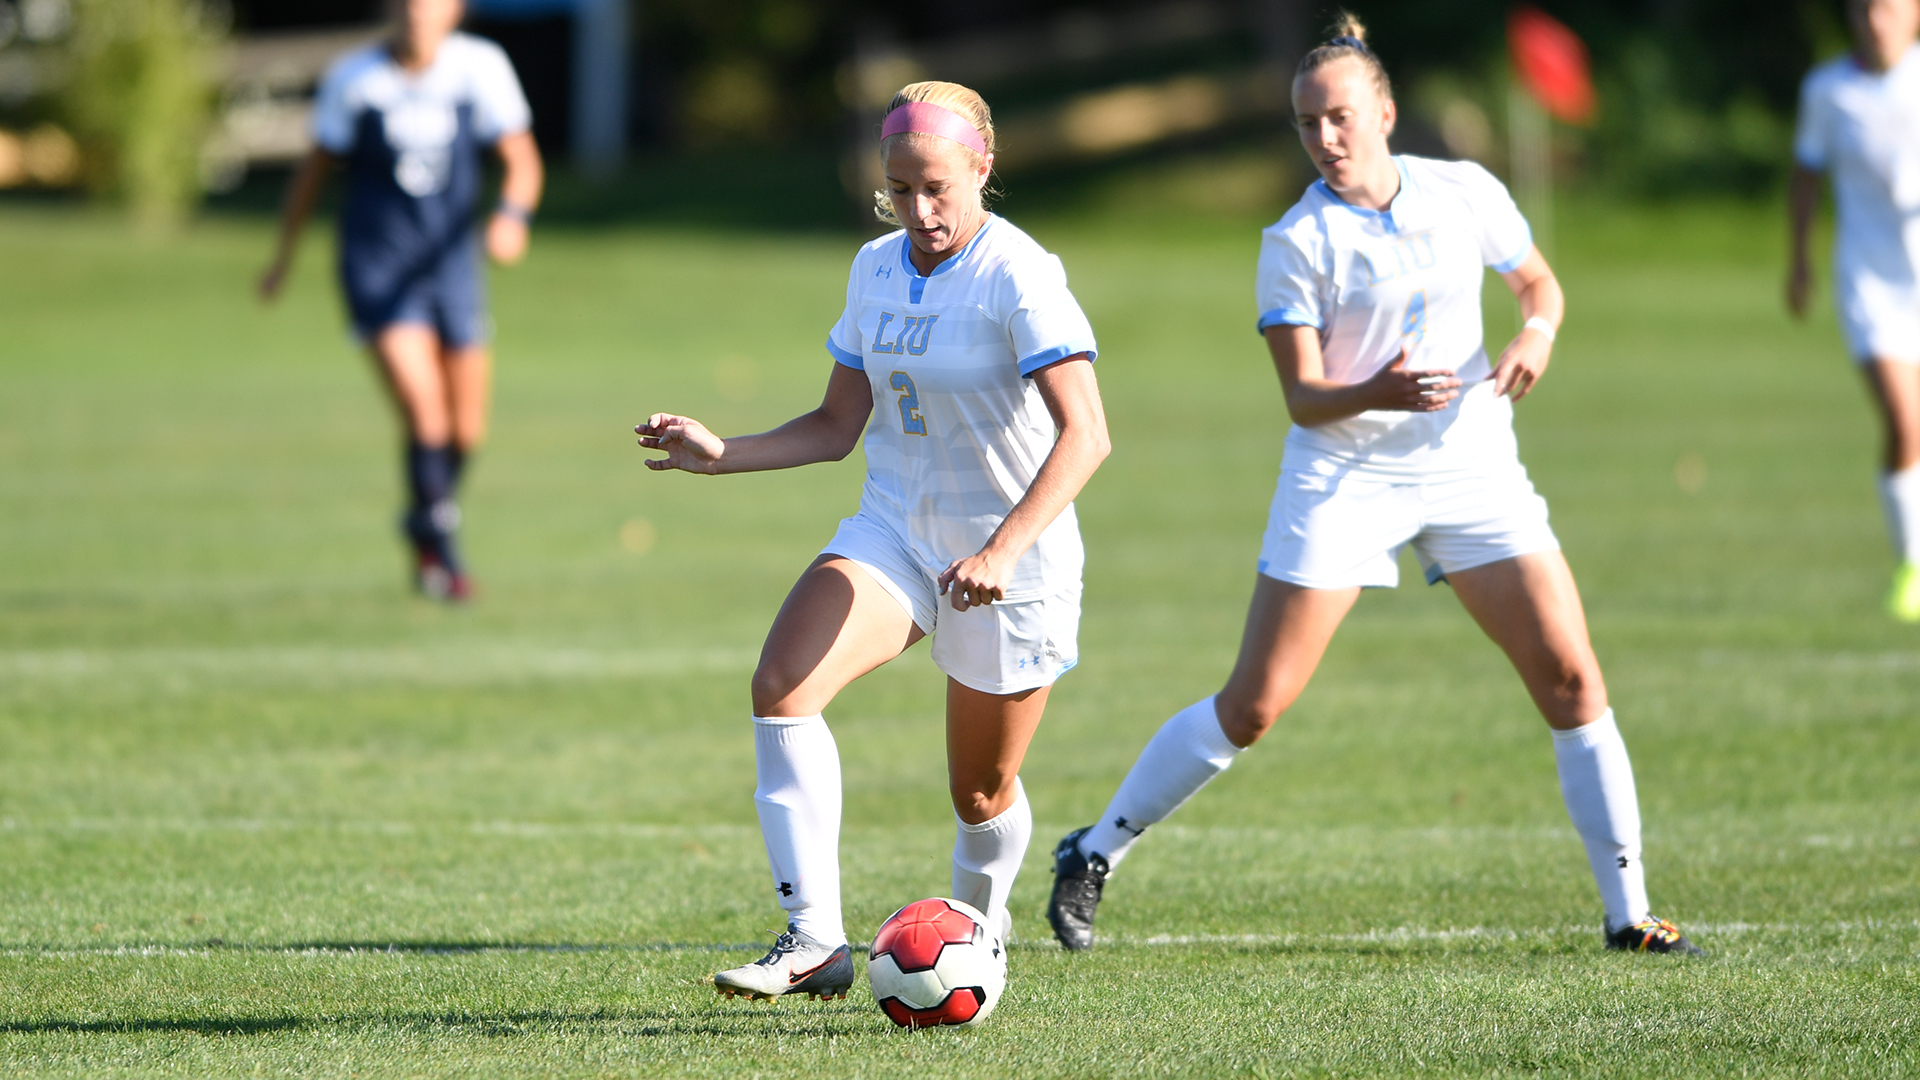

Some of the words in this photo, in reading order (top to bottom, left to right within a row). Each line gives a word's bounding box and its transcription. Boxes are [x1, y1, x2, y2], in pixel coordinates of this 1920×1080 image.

[1354, 230, 1436, 287] LIU
[872, 311, 939, 356] LIU
[1399, 289, 1427, 346] 4
[889, 371, 927, 436] 2
